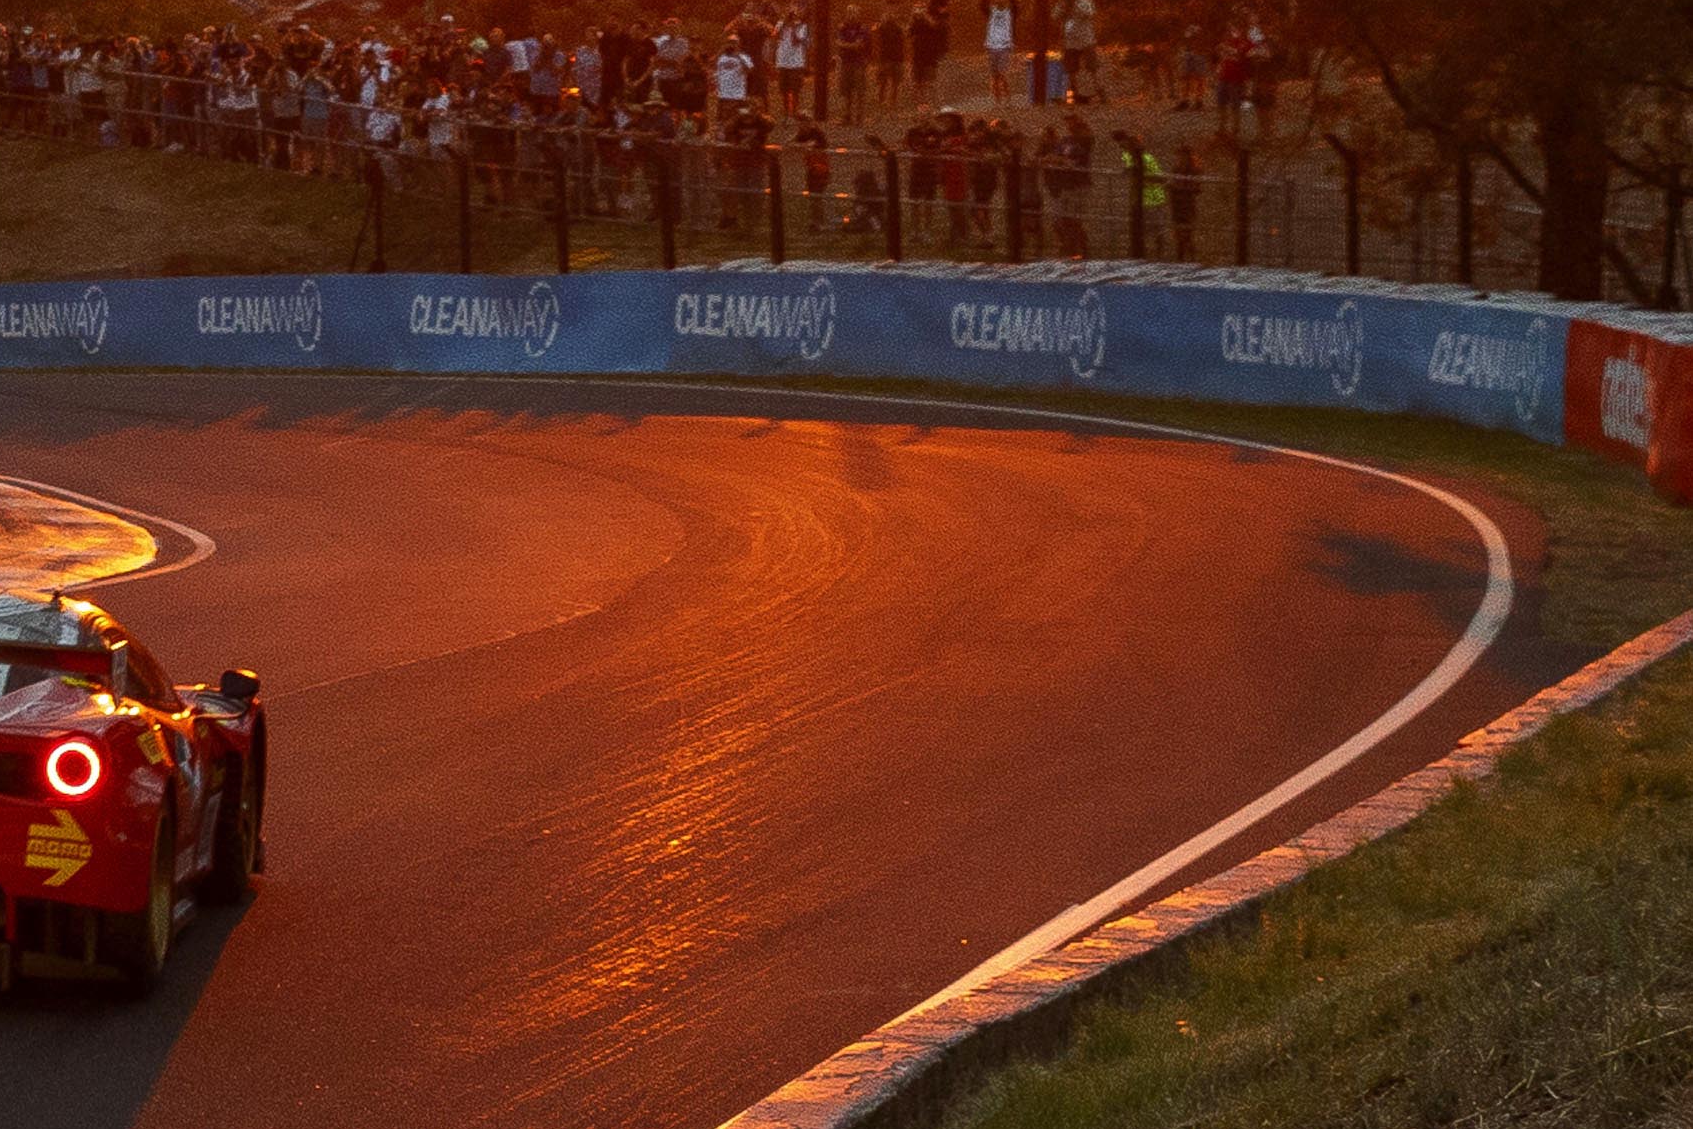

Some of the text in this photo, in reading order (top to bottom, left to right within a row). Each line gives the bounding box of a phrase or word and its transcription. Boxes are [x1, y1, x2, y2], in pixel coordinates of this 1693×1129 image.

[198, 295, 318, 334] CLEANAWAY
[408, 294, 554, 338] CLEANAWAY
[674, 293, 831, 338] CLEANAWAY
